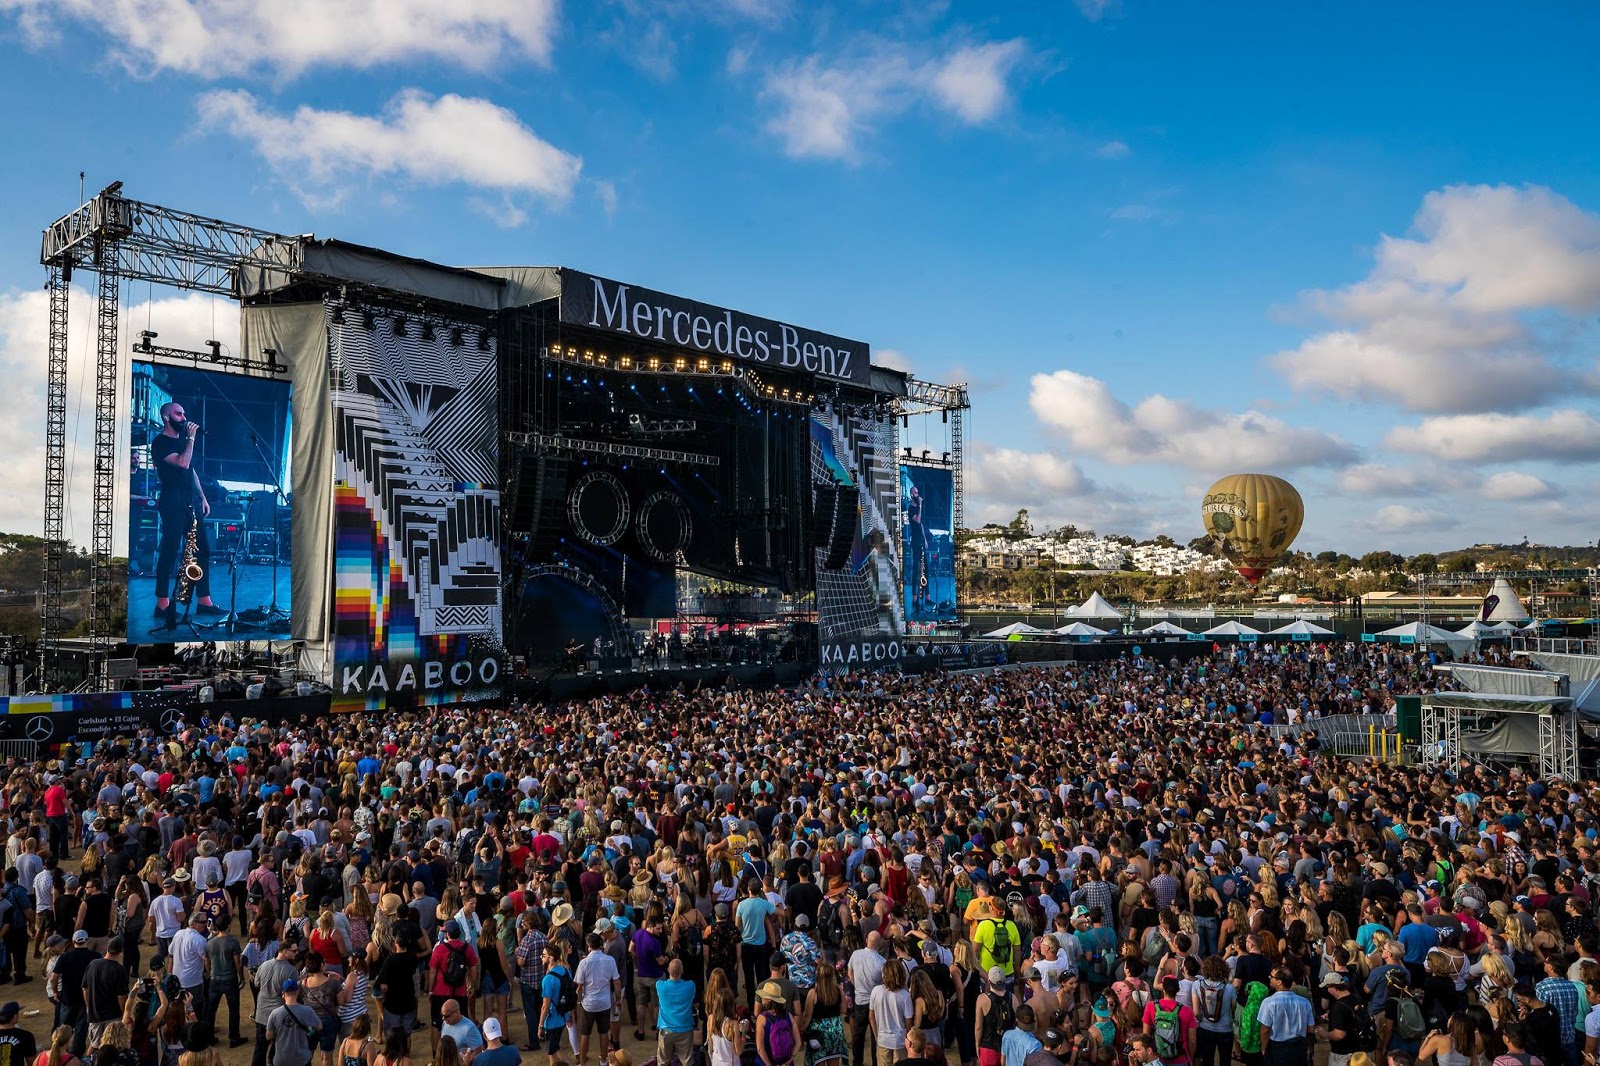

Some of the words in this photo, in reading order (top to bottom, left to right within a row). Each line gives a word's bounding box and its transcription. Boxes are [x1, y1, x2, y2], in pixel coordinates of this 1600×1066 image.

[589, 277, 852, 379] Mercedes-Benz
[821, 641, 899, 664] KAABOO
[342, 657, 498, 695] KAABOO
[78, 716, 107, 725] Carlsbad
[122, 715, 140, 724] Cajon
[79, 726, 111, 734] Escondido
[211, 904, 221, 917] 9
